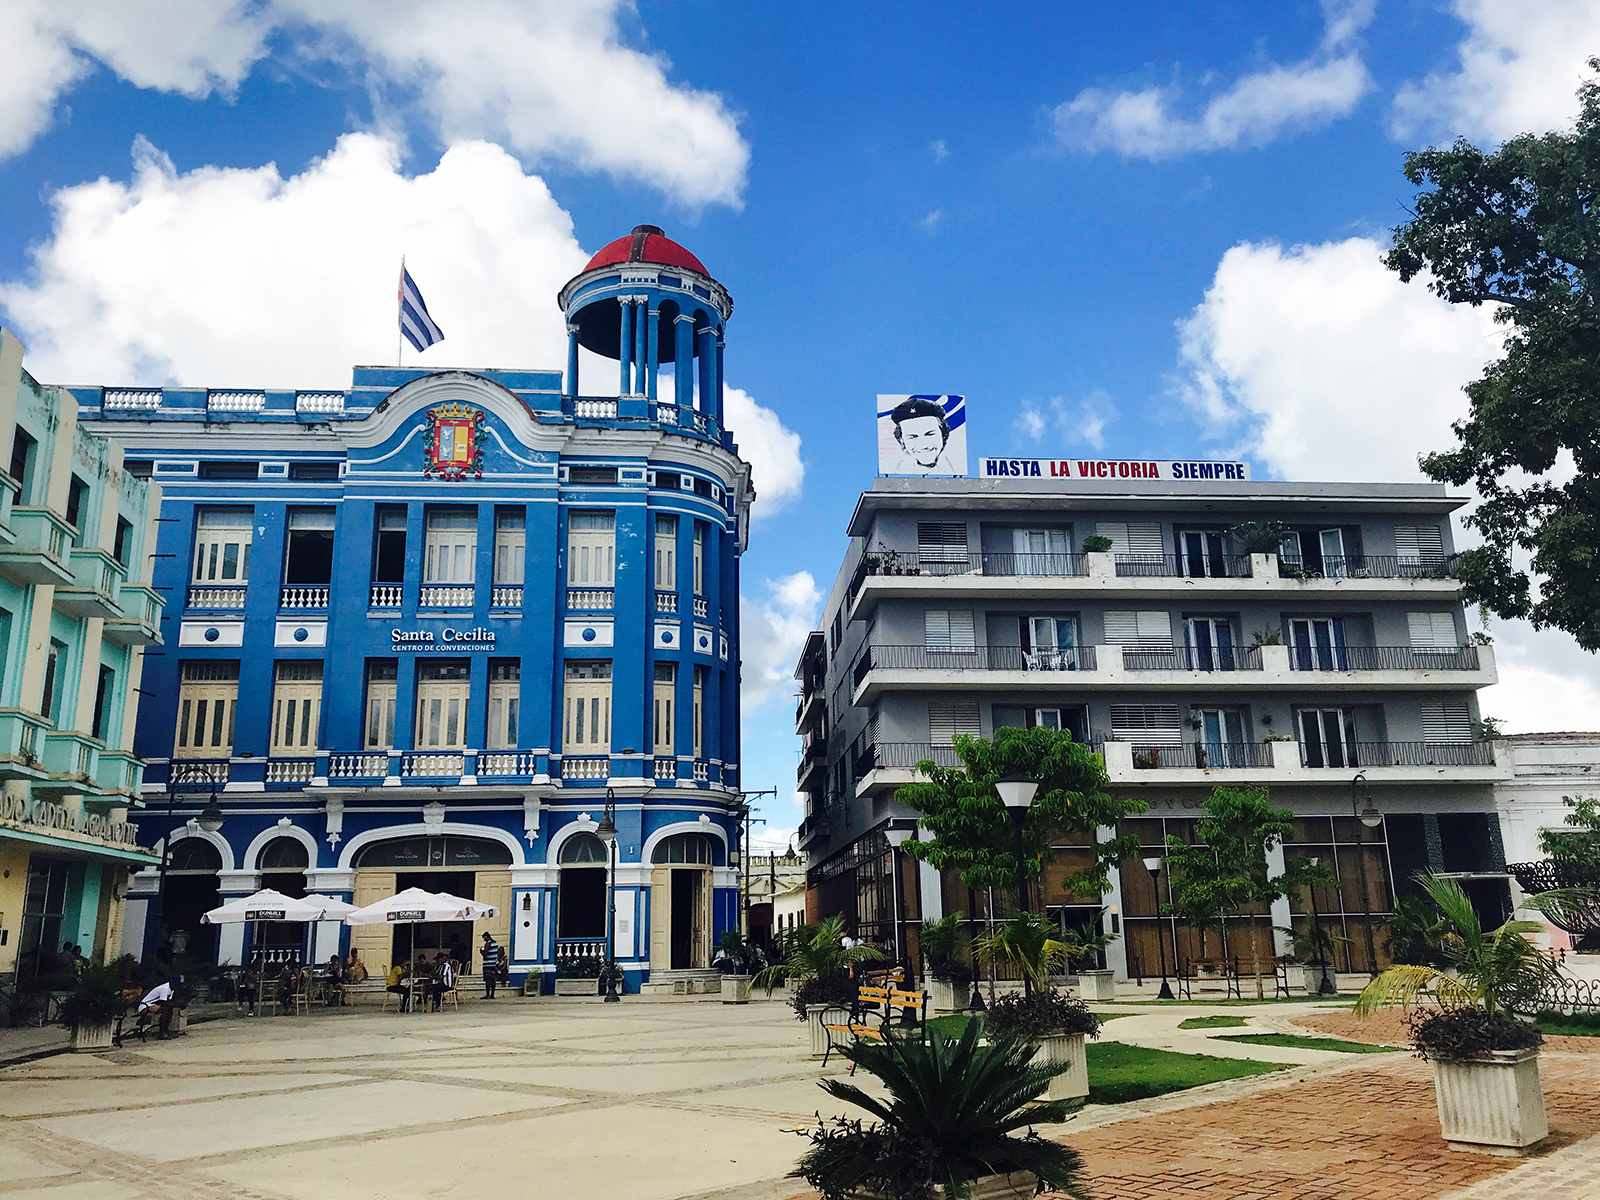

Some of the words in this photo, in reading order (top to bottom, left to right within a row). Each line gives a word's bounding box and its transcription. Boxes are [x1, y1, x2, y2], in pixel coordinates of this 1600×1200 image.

[986, 460, 1041, 477] HASTA
[1050, 461, 1070, 477] LA
[1078, 461, 1160, 479] VICTORIA
[1172, 462, 1245, 480] SIEMPRE
[391, 628, 434, 642] Santa
[442, 627, 496, 642] Cecilia
[391, 644, 423, 652] CENTRO
[424, 644, 434, 652] DE
[435, 644, 495, 652] CONVENCIONES
